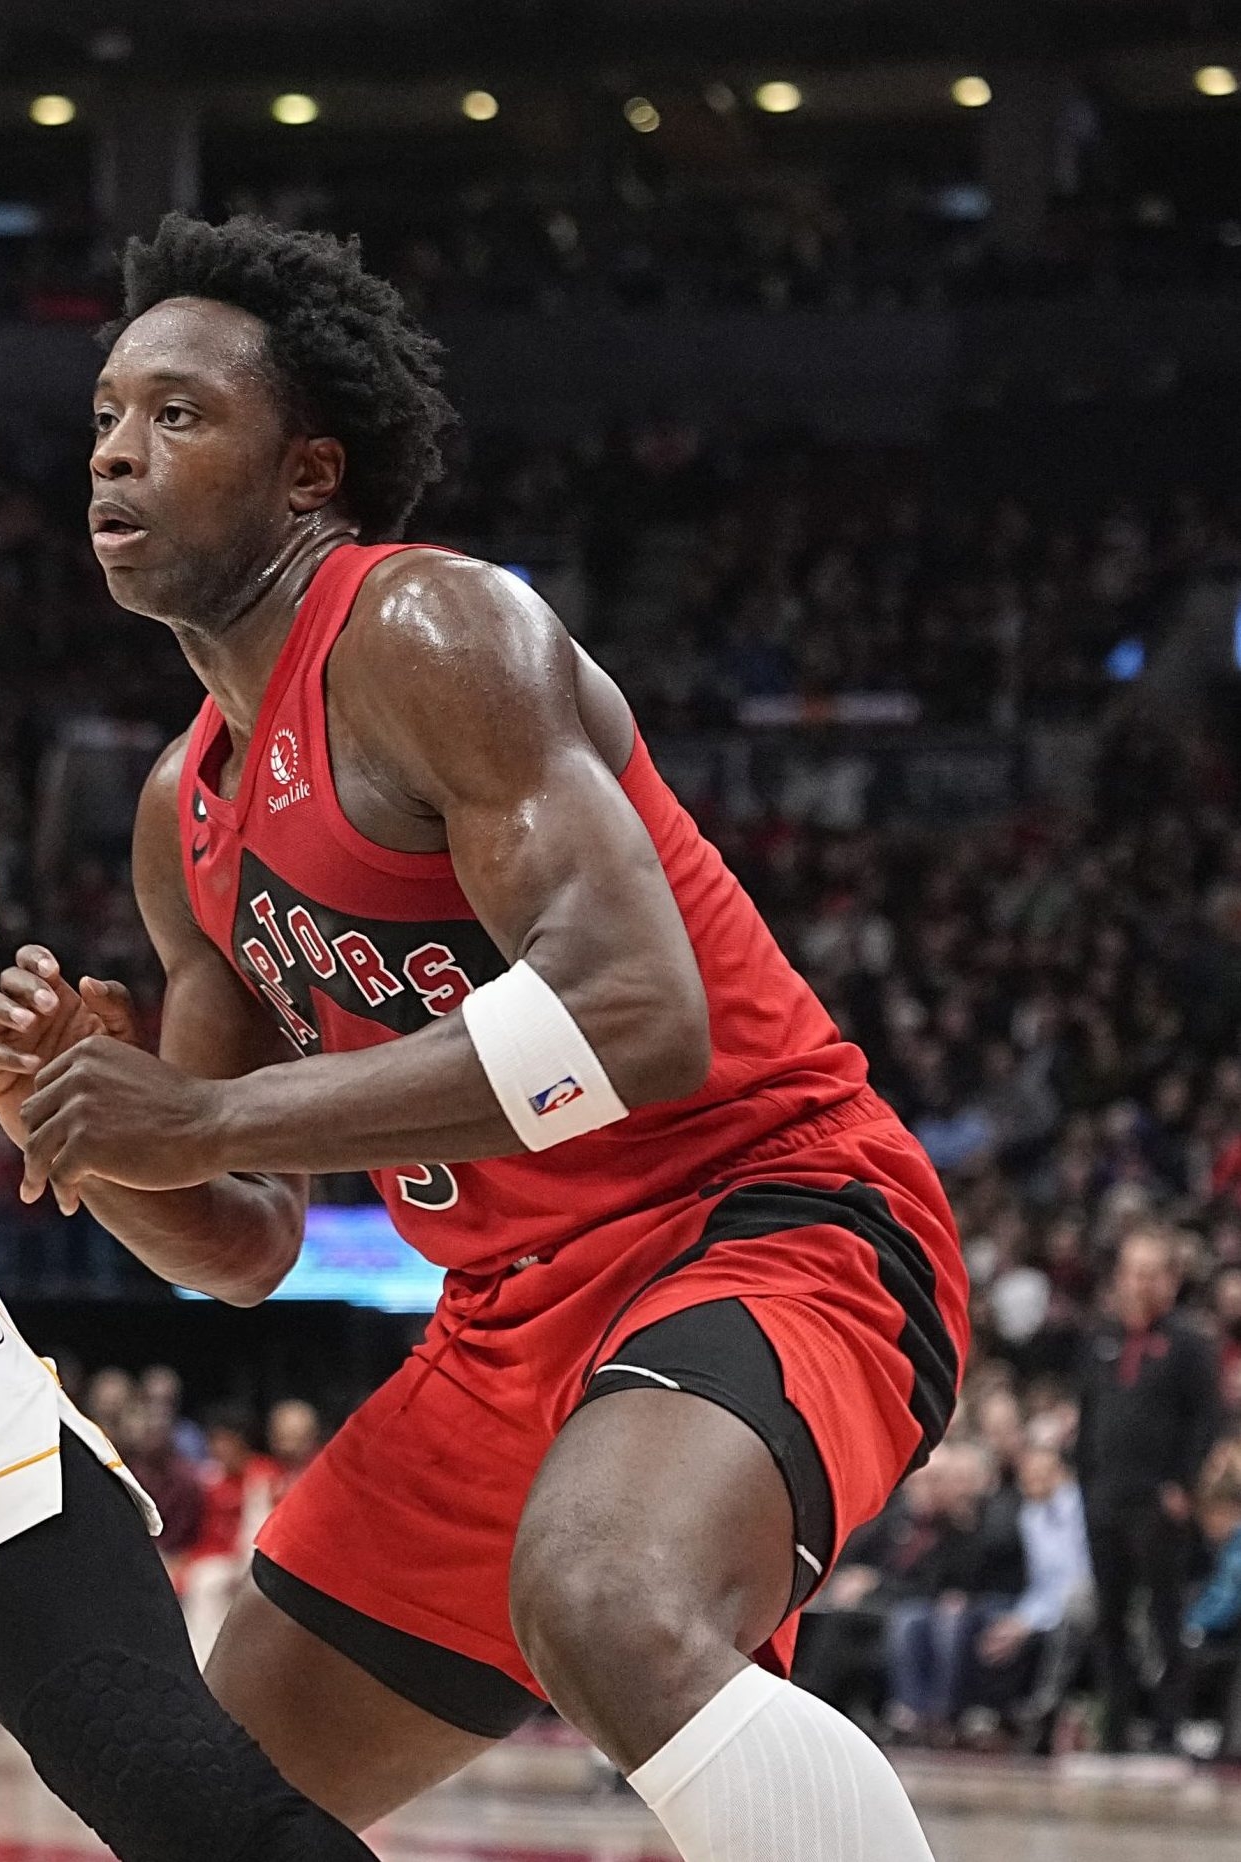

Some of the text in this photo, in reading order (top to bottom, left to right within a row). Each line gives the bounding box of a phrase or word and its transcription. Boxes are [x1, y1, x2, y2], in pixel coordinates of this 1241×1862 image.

[267, 779, 311, 814] Sun Life
[242, 890, 476, 1058] APTORS
